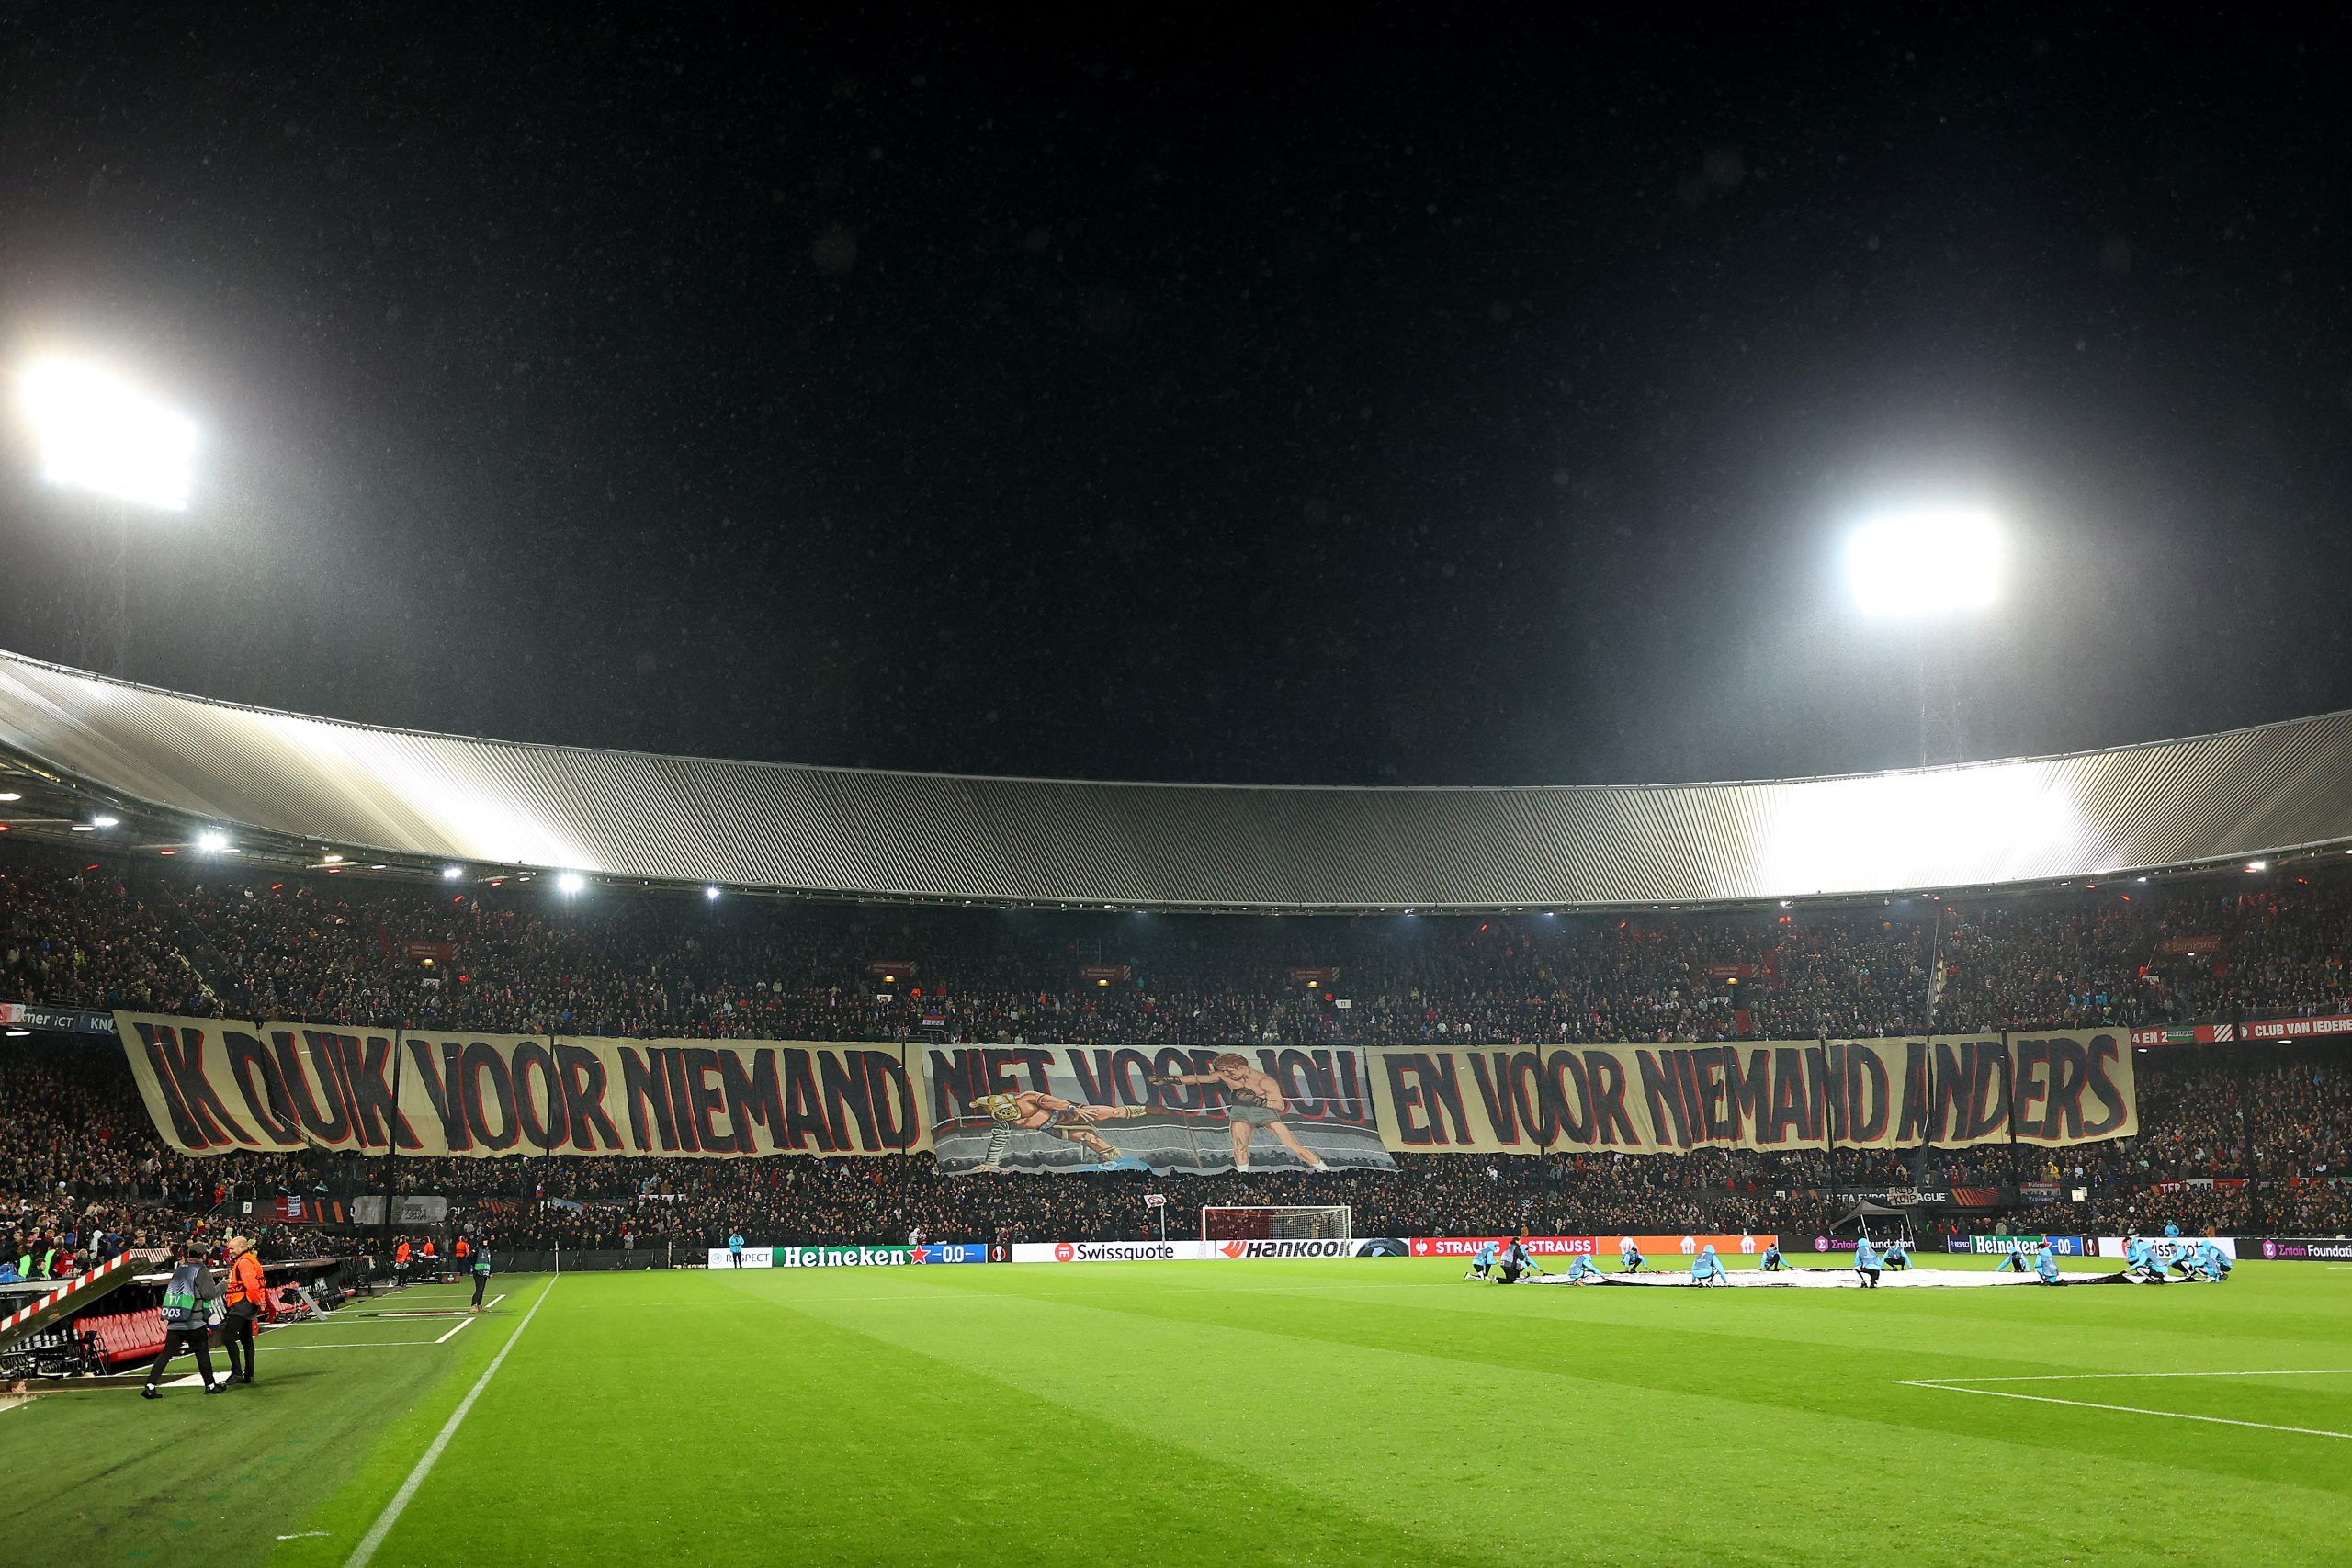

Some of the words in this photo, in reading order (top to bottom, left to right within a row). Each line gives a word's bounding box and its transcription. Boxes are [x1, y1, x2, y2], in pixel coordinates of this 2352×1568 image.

[2255, 1024, 2284, 1037] CLUB
[2286, 1021, 2311, 1034] VAN
[2143, 1032, 2158, 1043] EN
[132, 1022, 262, 1150] IK
[222, 1030, 424, 1150] DUIK
[406, 1041, 624, 1152] VOOR
[617, 1046, 920, 1154] NIEMAND
[928, 1048, 1056, 1128] NIET
[1066, 1047, 1229, 1120] VOOR
[1382, 1053, 1475, 1145] EN
[1467, 1050, 1642, 1147] VOOR
[1635, 1043, 1890, 1149] NIEMAND
[1896, 1034, 2128, 1143] ANDERS
[1529, 1240, 1591, 1253] STRAUSS
[1867, 1238, 1915, 1249] oundtion
[1975, 1235, 2038, 1255] Heineken
[2057, 1238, 2071, 1255] 0.0
[726, 1253, 770, 1263] RSPECT
[783, 1246, 906, 1268] Heineken
[943, 1245, 965, 1263] 0.0
[1077, 1243, 1174, 1261] Swissquote
[168, 1293, 180, 1305] TV
[161, 1307, 181, 1318] 003
